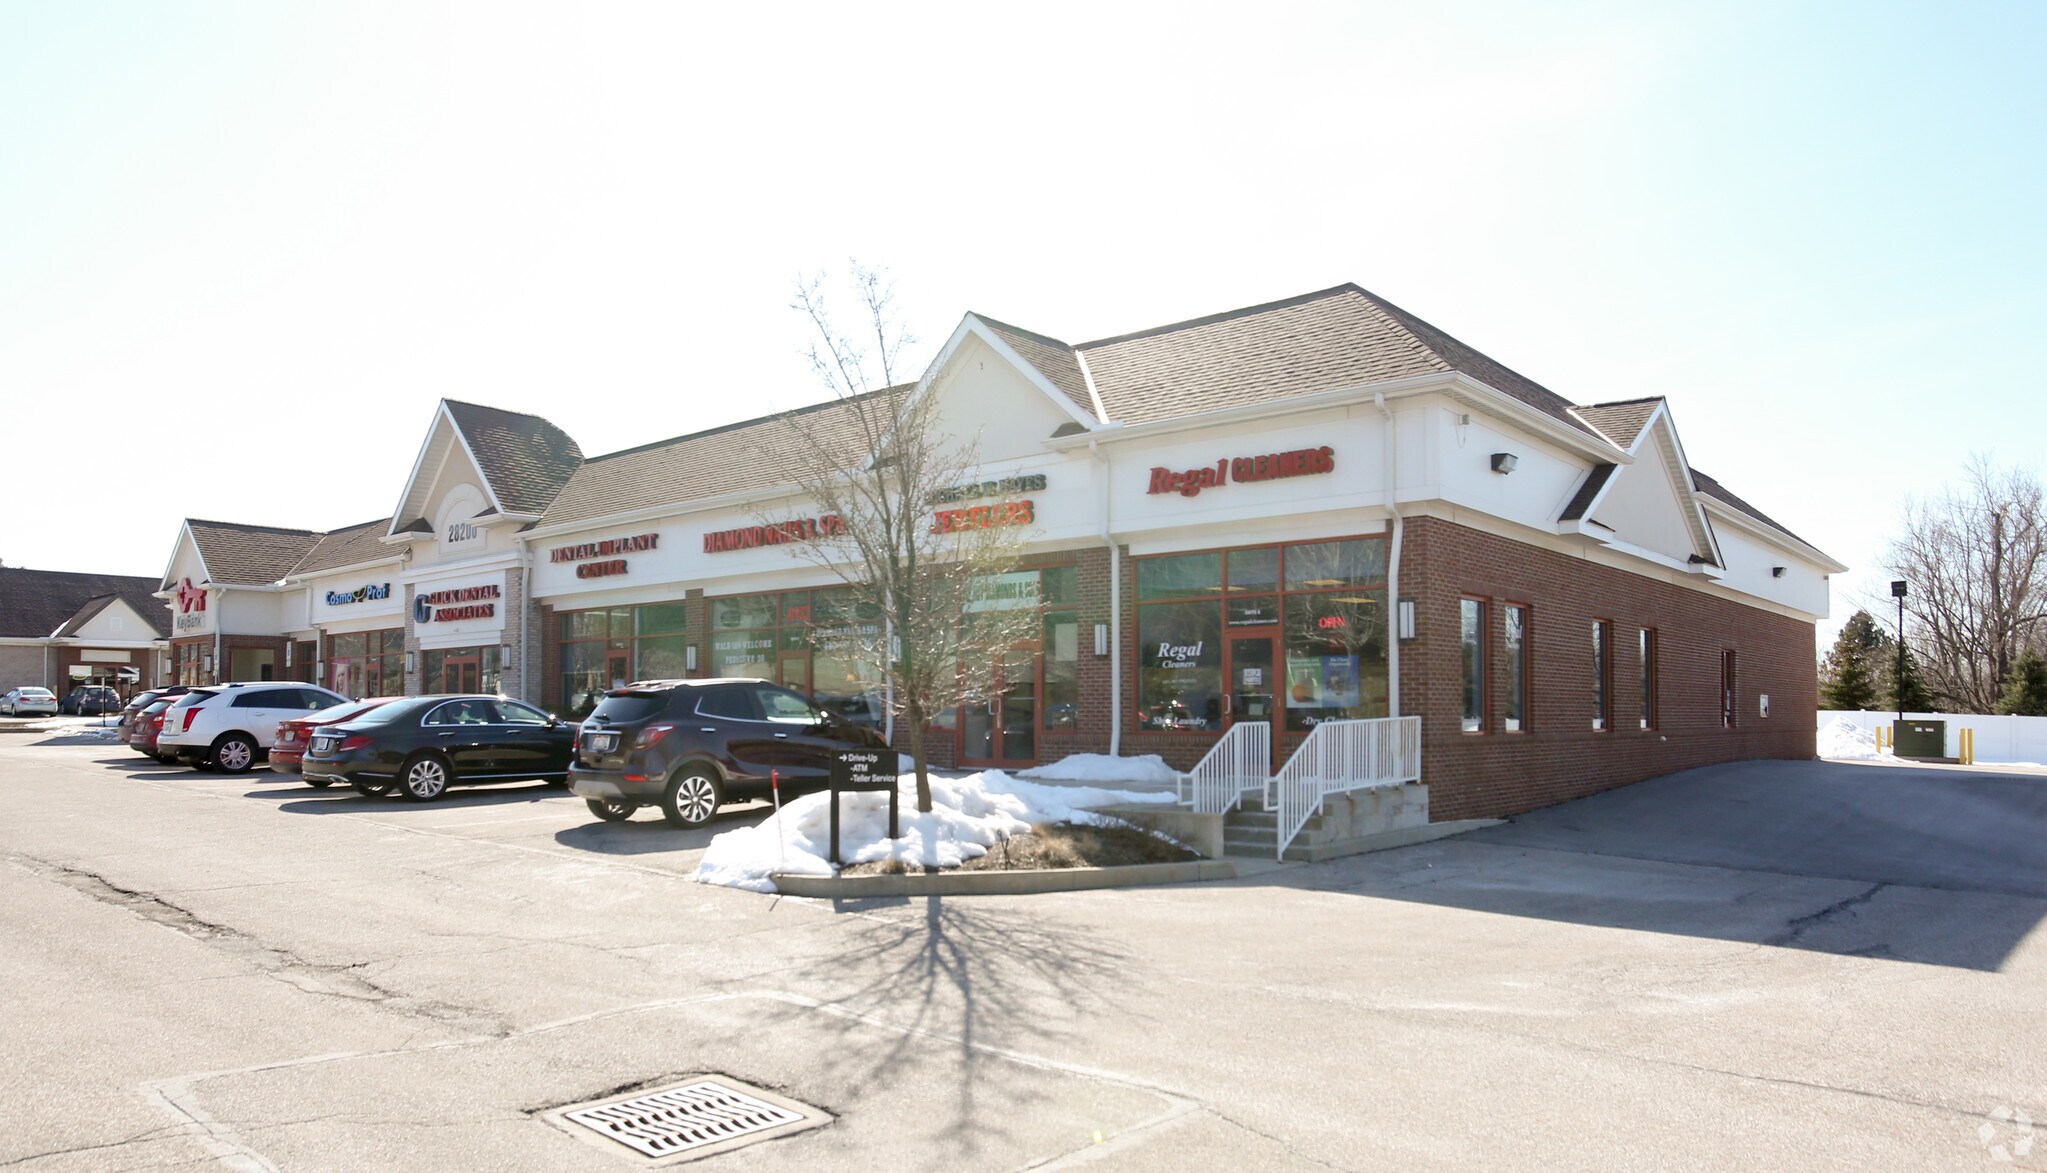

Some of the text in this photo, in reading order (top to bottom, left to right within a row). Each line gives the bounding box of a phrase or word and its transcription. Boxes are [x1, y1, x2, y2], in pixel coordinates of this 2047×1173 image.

[1146, 446, 1334, 497] Regal CLEANERS
[703, 526, 764, 553] DIAMOND
[549, 533, 660, 563] DENTAL IMPLANT
[576, 559, 628, 579] CENTER
[325, 591, 355, 606] Cosmo
[1318, 616, 1346, 629] OPEN
[1158, 642, 1202, 660] Regal
[1162, 660, 1197, 669] Cleaners
[1174, 716, 1208, 728] Laundry
[871, 773, 897, 783] Service
